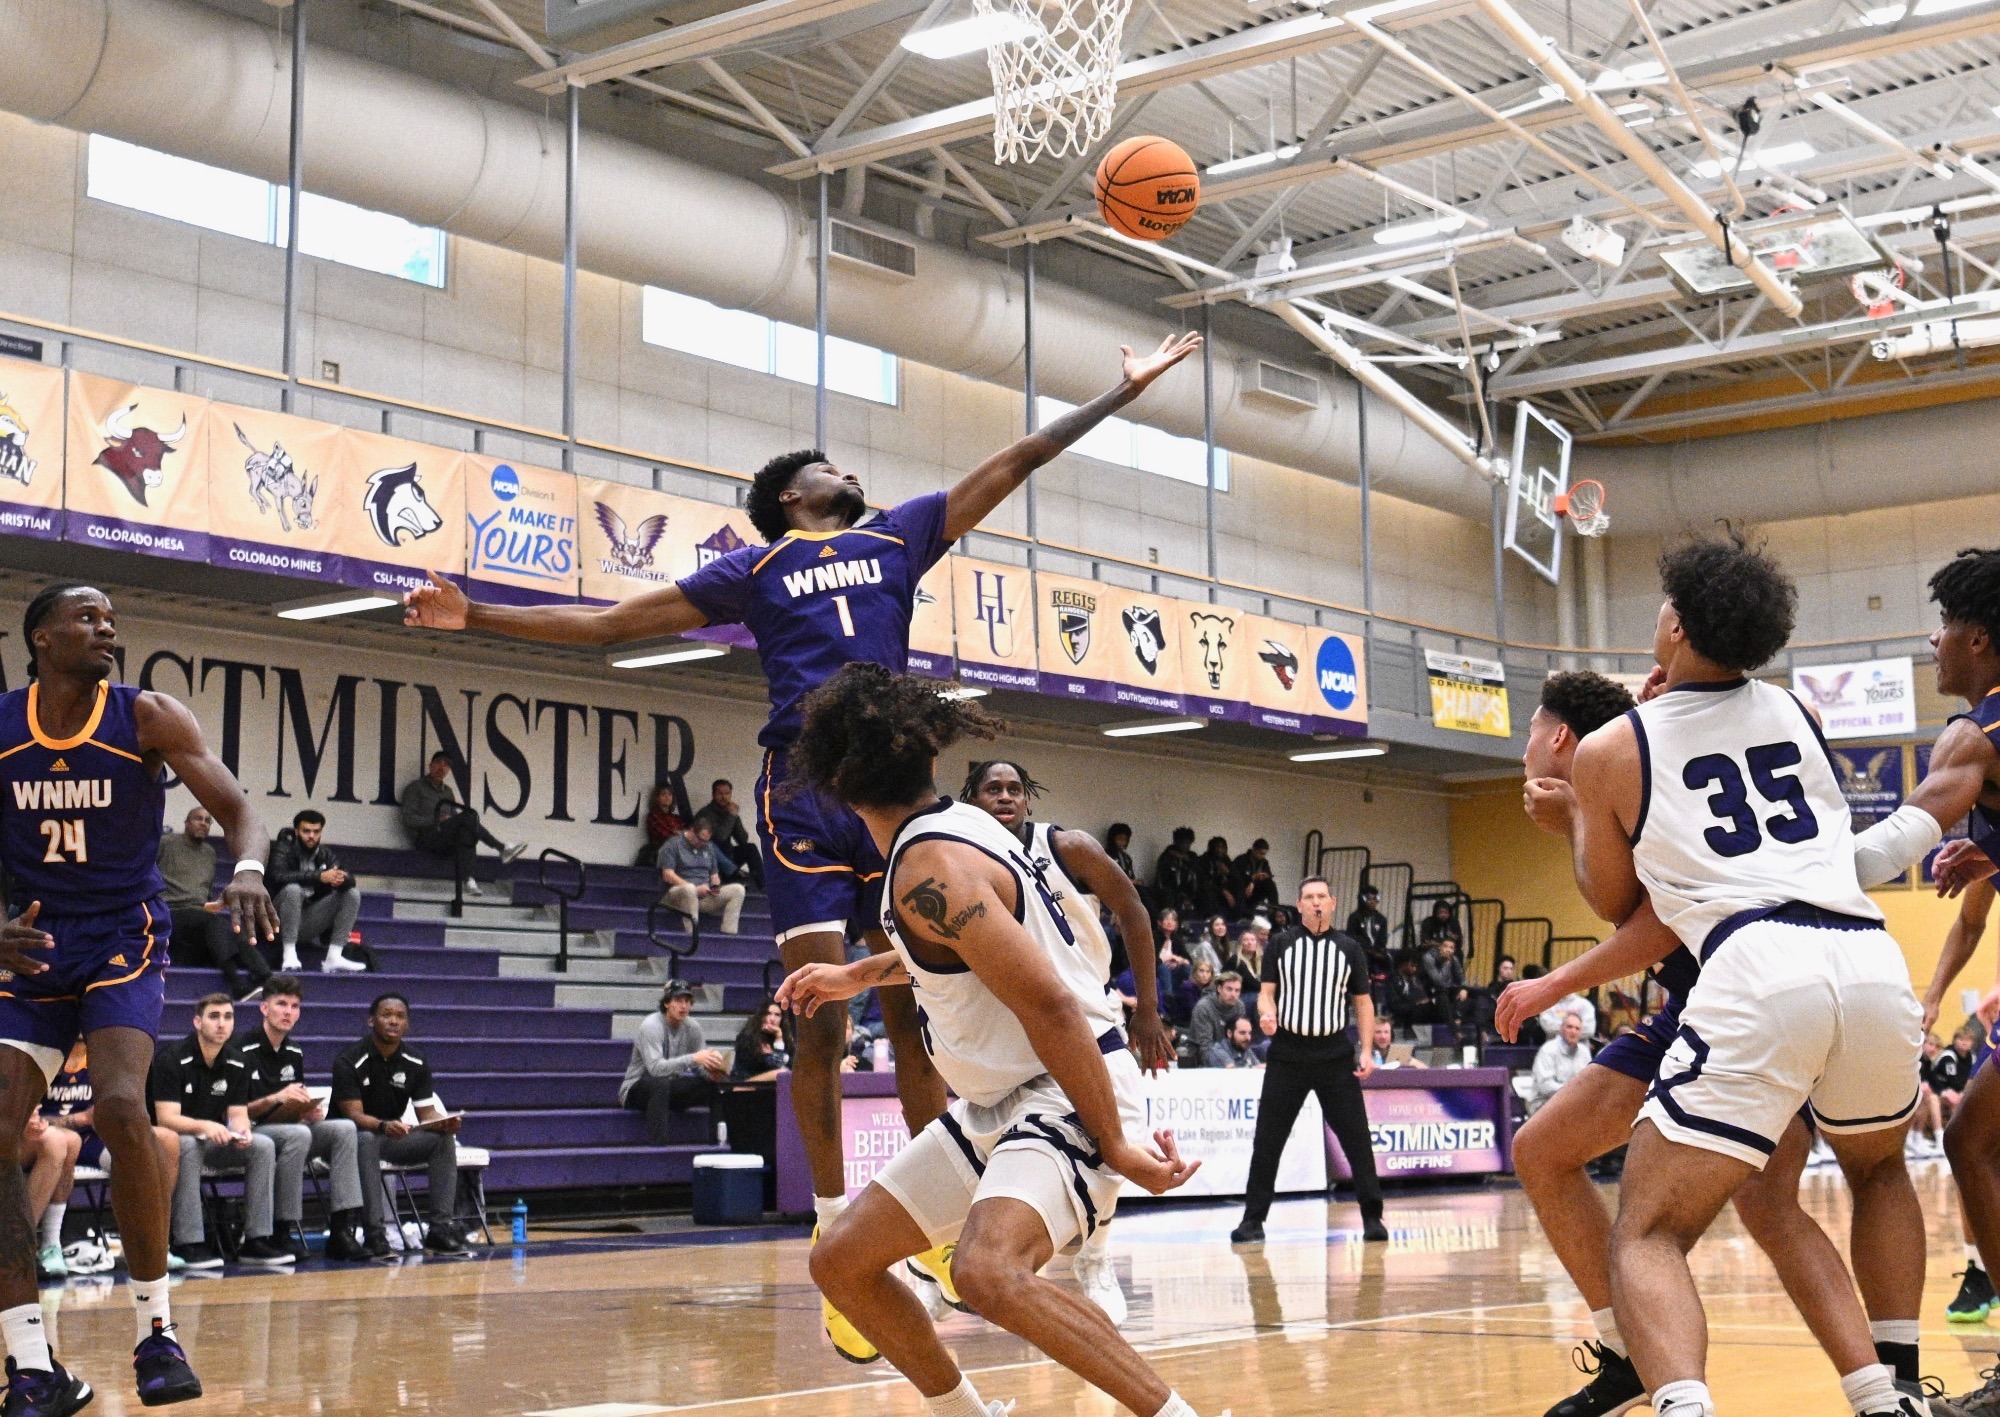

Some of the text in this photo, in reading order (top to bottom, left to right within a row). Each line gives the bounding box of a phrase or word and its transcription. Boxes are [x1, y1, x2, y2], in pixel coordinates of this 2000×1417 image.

[1156, 187, 1196, 205] NCAA
[493, 480, 519, 495] NCAA
[521, 486, 549, 500] Division
[508, 507, 575, 534] MAKE IT
[87, 524, 185, 552] COLORADO MESA
[467, 510, 573, 574] YOURS
[229, 548, 322, 573] COLORADO MINES
[783, 558, 883, 598] WNMU
[1052, 590, 1096, 612] REGIS
[1060, 605, 1089, 617] RANGERS
[831, 595, 855, 637] 1
[960, 668, 1036, 686] NEW MEXICO HIGHLANDS
[1321, 669, 1357, 695] NCAA
[1430, 678, 1501, 696] CONFERENCE
[1068, 683, 1086, 694] REGIS
[1864, 684, 1904, 705] YOURS
[1117, 691, 1179, 709] SOUTH DAKOTA MINES
[1262, 714, 1300, 728] WESTERN STATE
[12, 779, 112, 810] WNMU
[1682, 741, 1819, 858] 35
[40, 819, 88, 863] 24
[47, 1084, 93, 1102] WNMU
[1156, 1098, 1260, 1121] SPORTSME
[1177, 1128, 1197, 1141] Lake
[1200, 1127, 1233, 1143] Regional
[1368, 1121, 1495, 1153] ESTMINSTER
[1386, 1154, 1453, 1170] GRIFFINS
